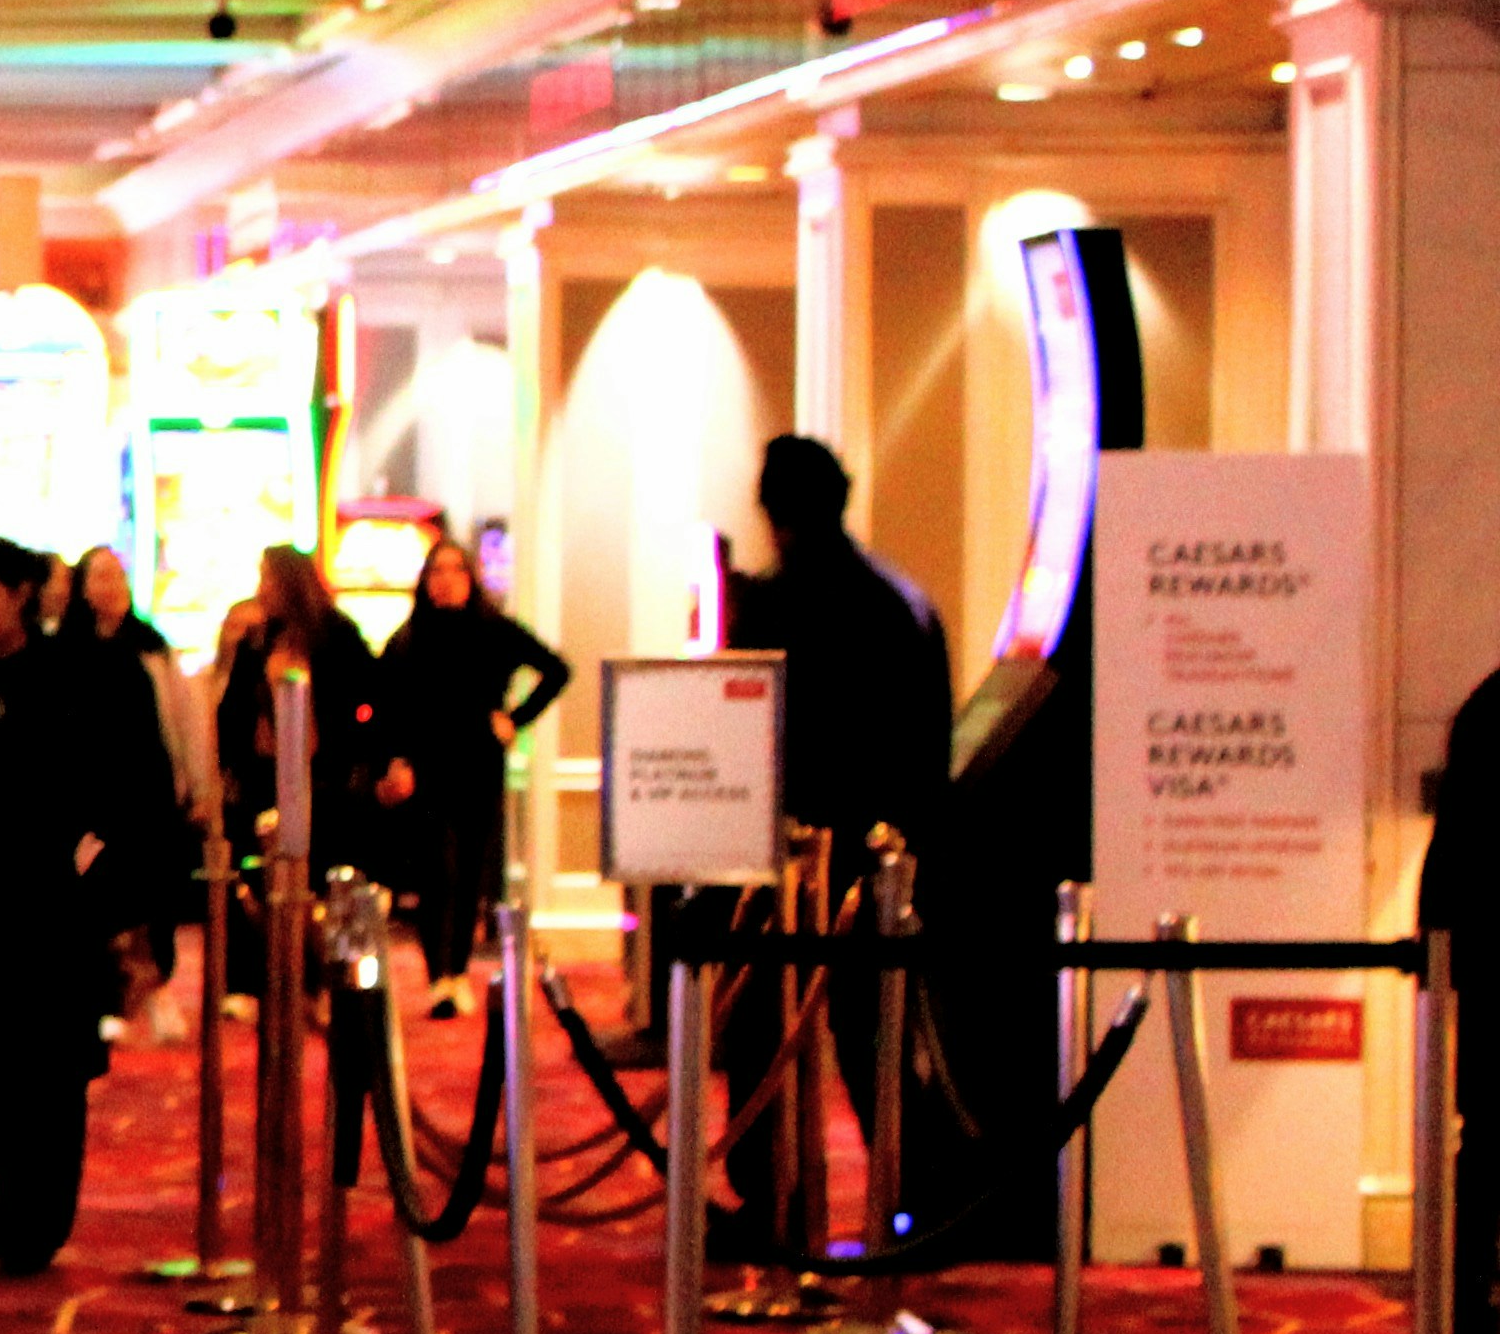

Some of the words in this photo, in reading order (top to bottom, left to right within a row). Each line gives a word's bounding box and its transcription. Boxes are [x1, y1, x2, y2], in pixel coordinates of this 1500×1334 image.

[1149, 540, 1286, 566] CAESARS
[1149, 711, 1286, 739] CAESARS
[1149, 743, 1297, 771] REWARDS
